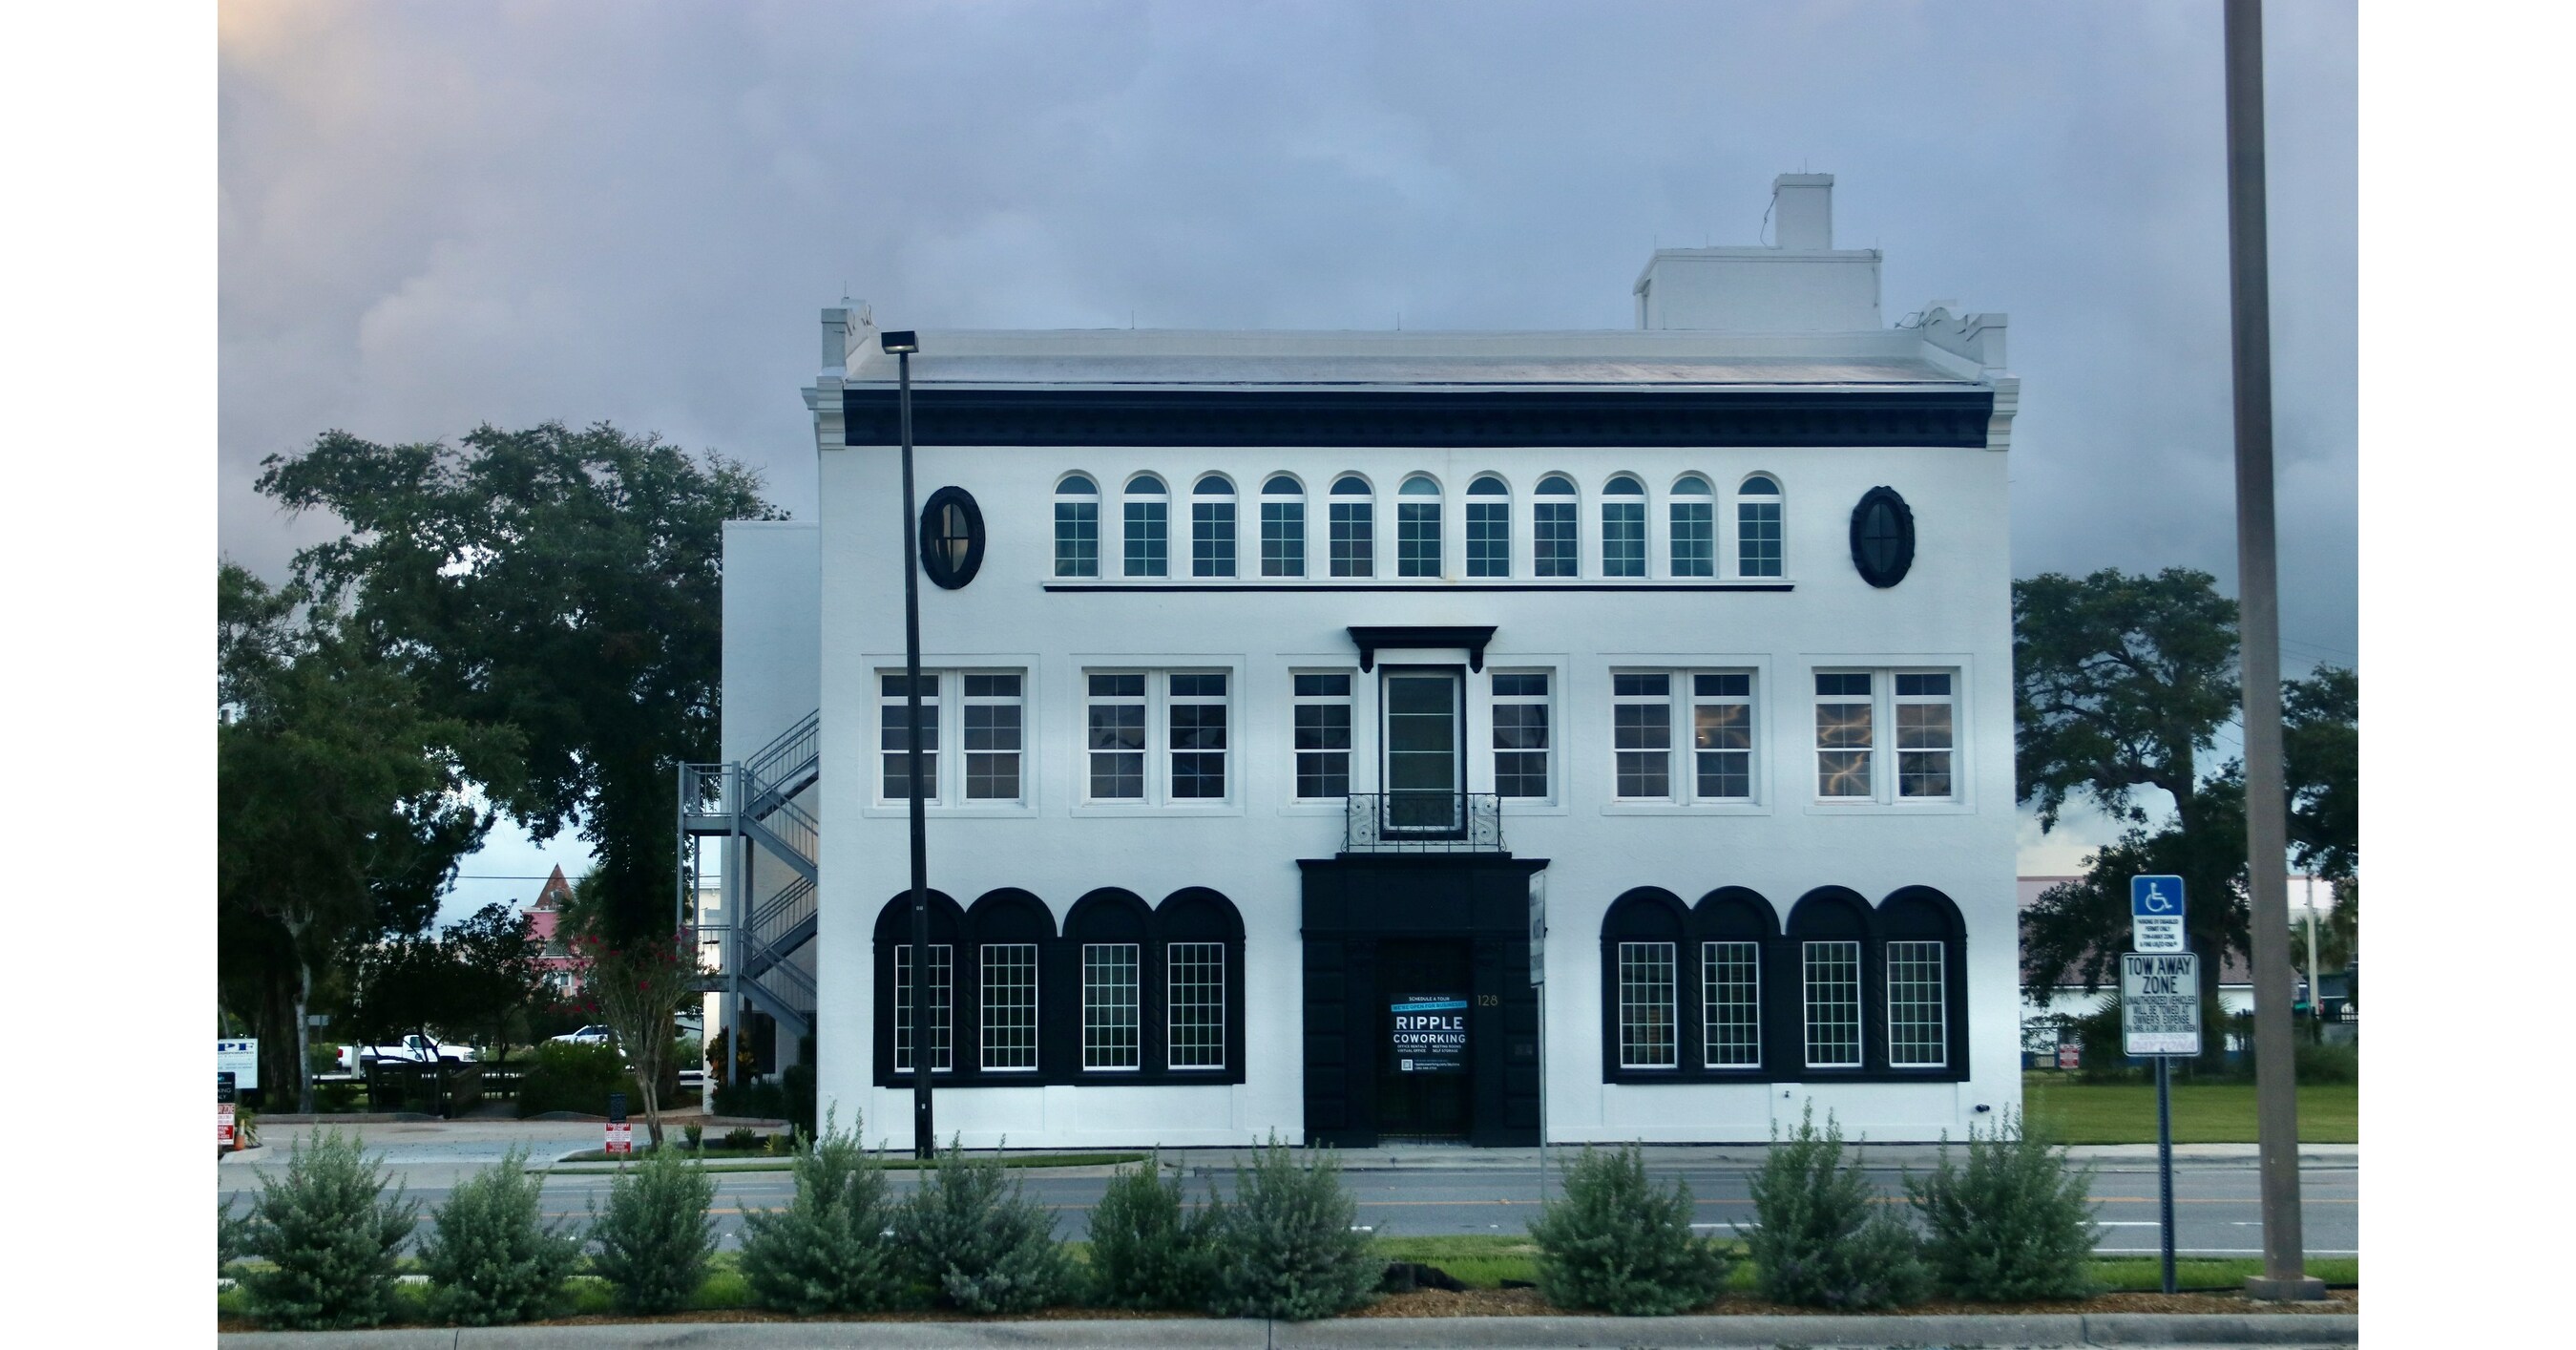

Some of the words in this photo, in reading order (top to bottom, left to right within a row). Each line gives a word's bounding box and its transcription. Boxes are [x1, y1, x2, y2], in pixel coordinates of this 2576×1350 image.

[2126, 957, 2153, 975] TOW
[2157, 957, 2191, 975] AWAY
[2143, 976, 2178, 994] ZONE
[1476, 995, 1498, 1006] 128
[2125, 996, 2168, 1005] UNAUTHORIZED
[2168, 996, 2196, 1005] VEHICLES
[2133, 1005, 2147, 1015] WILL
[2148, 1005, 2156, 1015] BE
[2159, 1005, 2180, 1015] TOWED
[2182, 1005, 2189, 1015] AT
[1396, 1016, 1463, 1029] RIPPLE
[2133, 1015, 2160, 1024] OWNER'S
[2163, 1015, 2190, 1024] EXPENSE
[1393, 1034, 1466, 1044] COWORKING
[2131, 1041, 2197, 1052] DAYTONA
